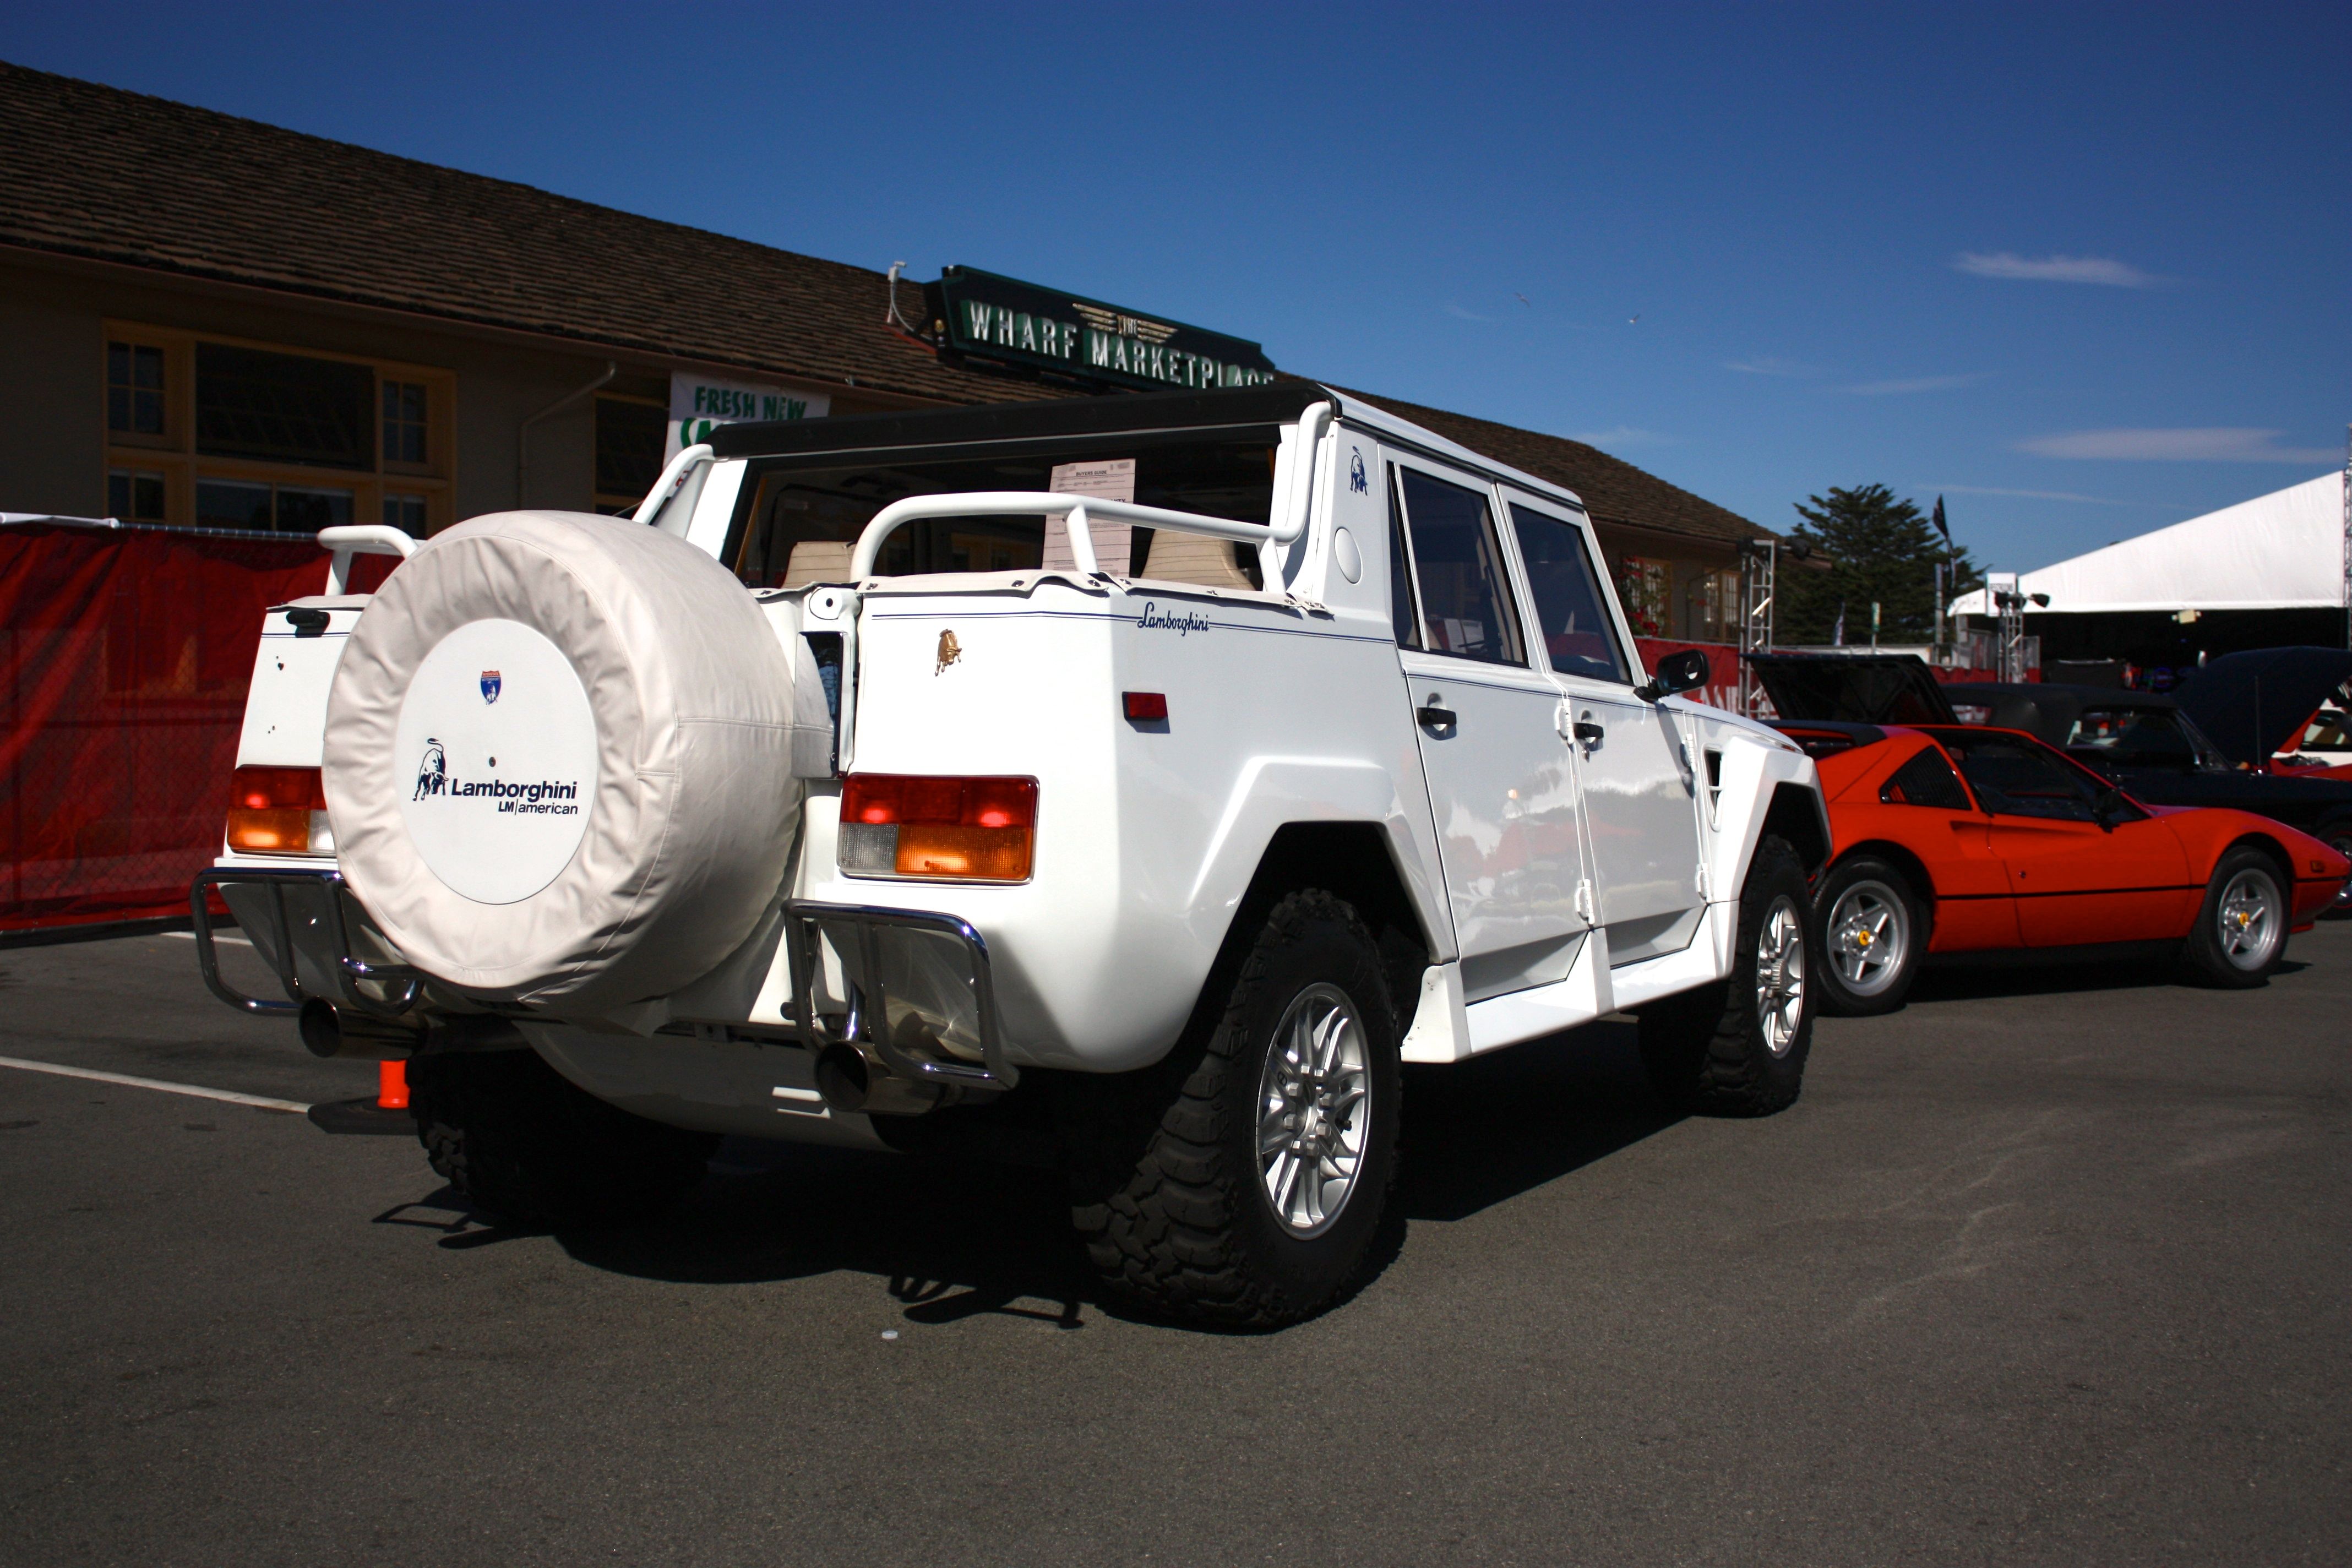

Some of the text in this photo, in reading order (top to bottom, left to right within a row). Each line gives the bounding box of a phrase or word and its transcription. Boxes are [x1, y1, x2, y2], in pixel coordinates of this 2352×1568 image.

[968, 300, 1077, 359] WHARF
[1119, 315, 1139, 335] THE
[694, 386, 807, 420] FRESH NEW
[1137, 601, 1210, 637] Lamborghini
[451, 778, 578, 803] Lamborghini
